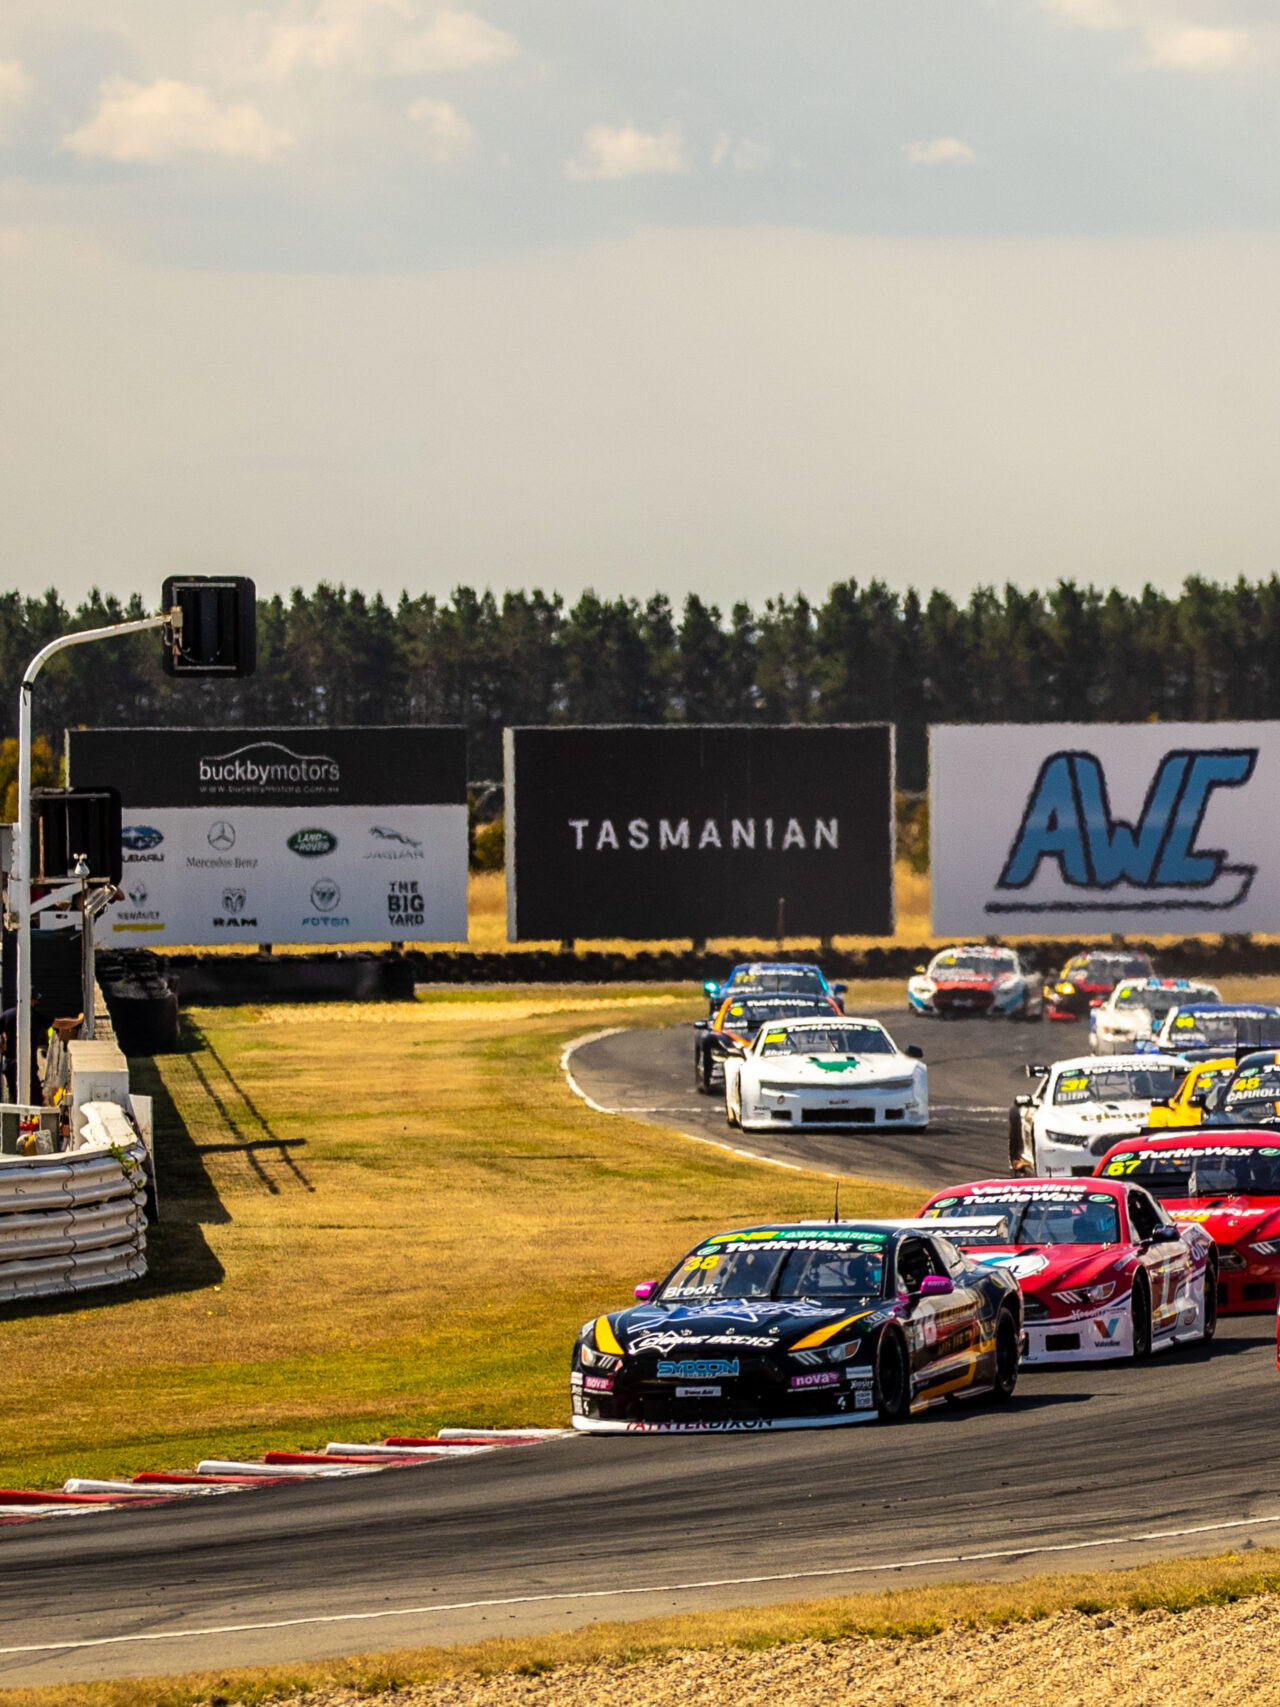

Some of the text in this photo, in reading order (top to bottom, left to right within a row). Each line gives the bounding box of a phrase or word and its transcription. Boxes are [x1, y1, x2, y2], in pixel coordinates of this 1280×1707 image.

[199, 759, 340, 785] buckbymotors
[996, 750, 1259, 889] AWC
[568, 818, 839, 850] TASMANIAN
[122, 853, 165, 863] UBARU
[388, 881, 419, 894] THE
[387, 894, 425, 913] BIG
[212, 917, 258, 928] RAM
[388, 914, 425, 927] YARD
[1197, 1077, 1212, 1089] 4
[1233, 1077, 1260, 1091] 48
[1138, 1146, 1254, 1160] TurtleWax
[1107, 1159, 1142, 1176] 67
[970, 1183, 1088, 1195] Valvoline
[962, 1191, 1084, 1206] TurtleWax
[724, 1239, 853, 1254] TurtleWax
[683, 1254, 720, 1272] 38
[662, 1283, 720, 1300] Brook
[657, 1360, 740, 1376] SYDCON
[796, 1374, 830, 1386] nova
